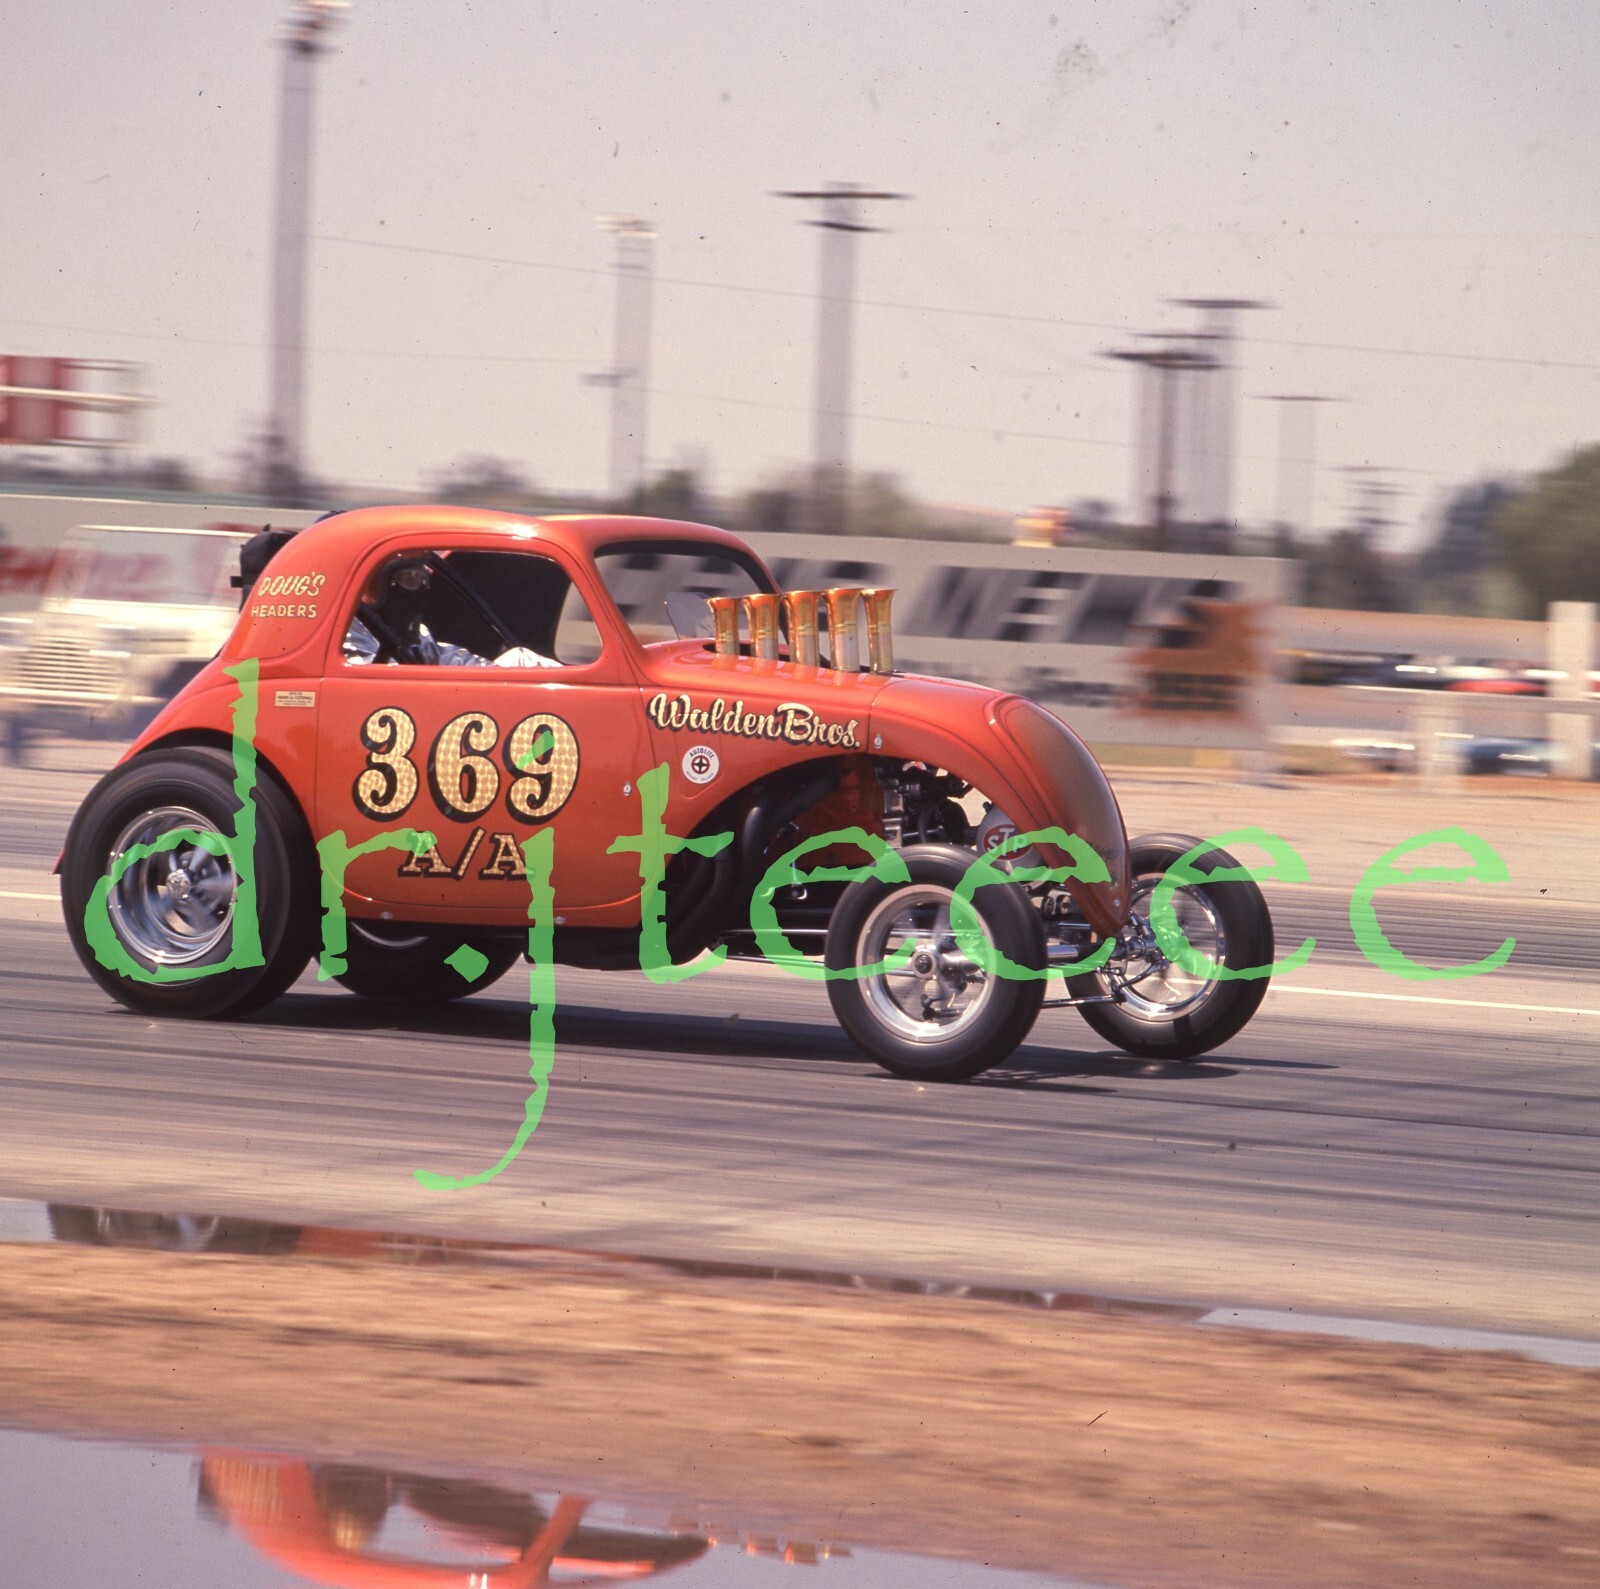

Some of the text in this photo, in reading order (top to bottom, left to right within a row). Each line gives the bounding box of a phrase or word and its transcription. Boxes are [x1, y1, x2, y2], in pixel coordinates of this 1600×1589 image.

[257, 571, 326, 597] DOUG'S
[250, 604, 318, 619] HEADERS
[646, 692, 862, 748] Walden Bros.
[352, 705, 581, 823] 369
[689, 747, 715, 759] AUTOLITE
[398, 826, 536, 881] A/A
[986, 827, 1029, 857] STP
